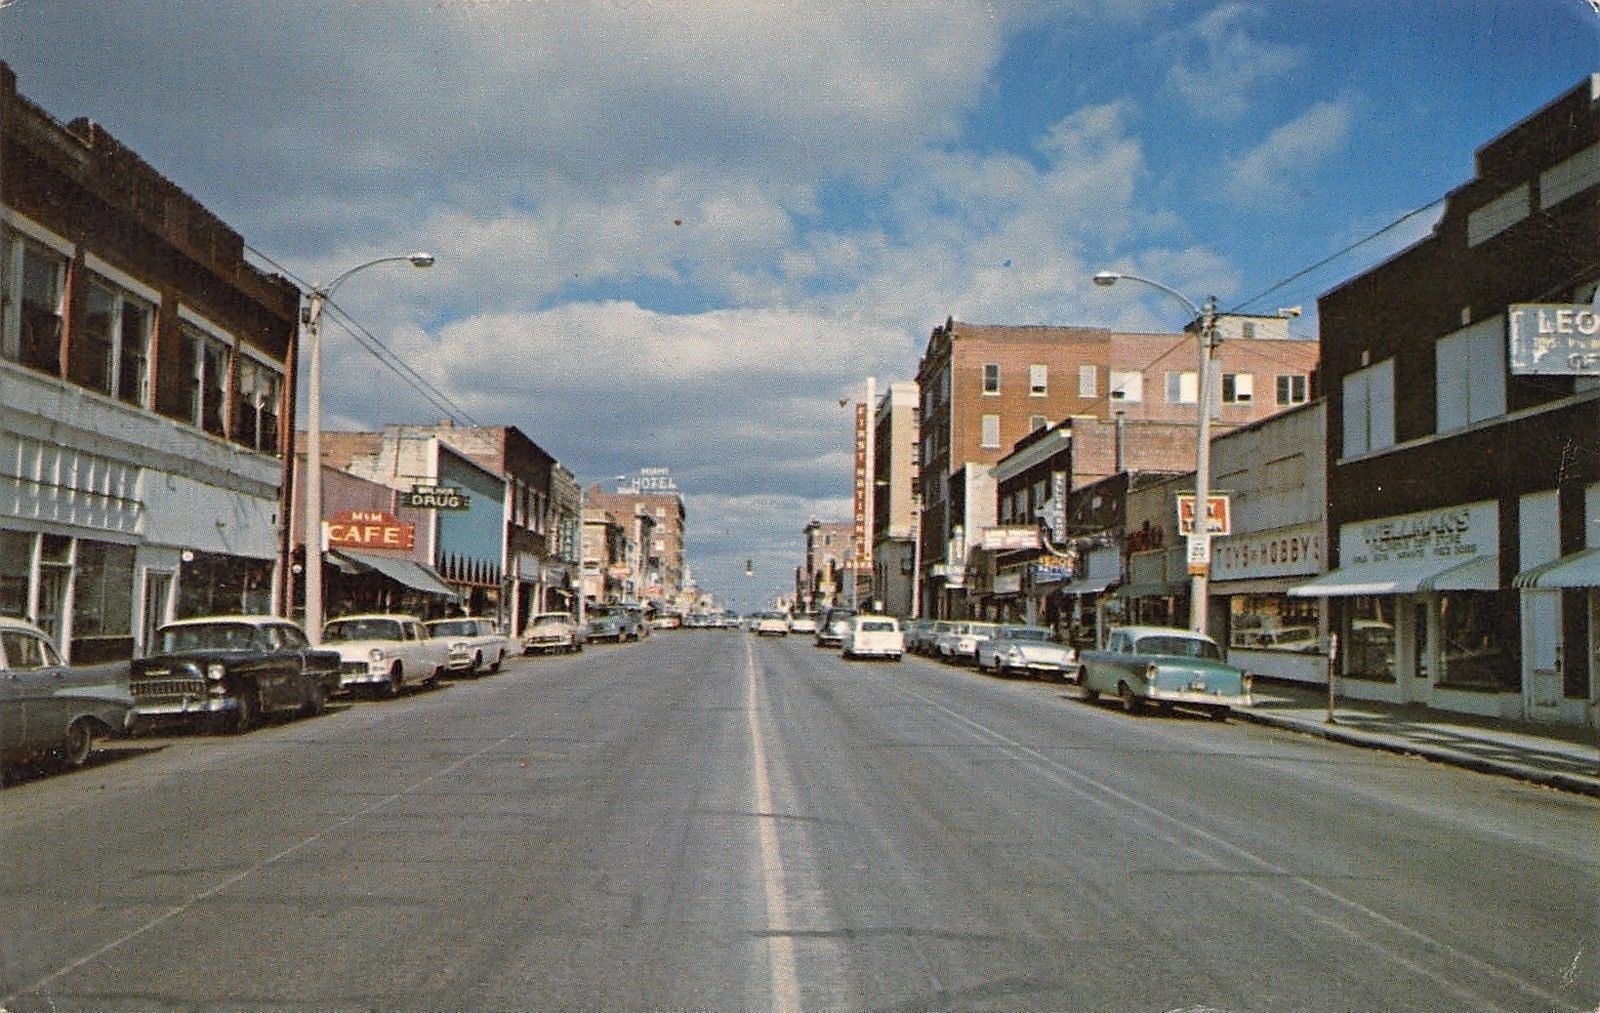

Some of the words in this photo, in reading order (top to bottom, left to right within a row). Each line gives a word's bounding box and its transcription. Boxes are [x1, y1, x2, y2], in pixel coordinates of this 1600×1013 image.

[631, 477, 676, 489] HOTEL
[412, 494, 459, 507] DRUG
[328, 525, 401, 544] CAFE
